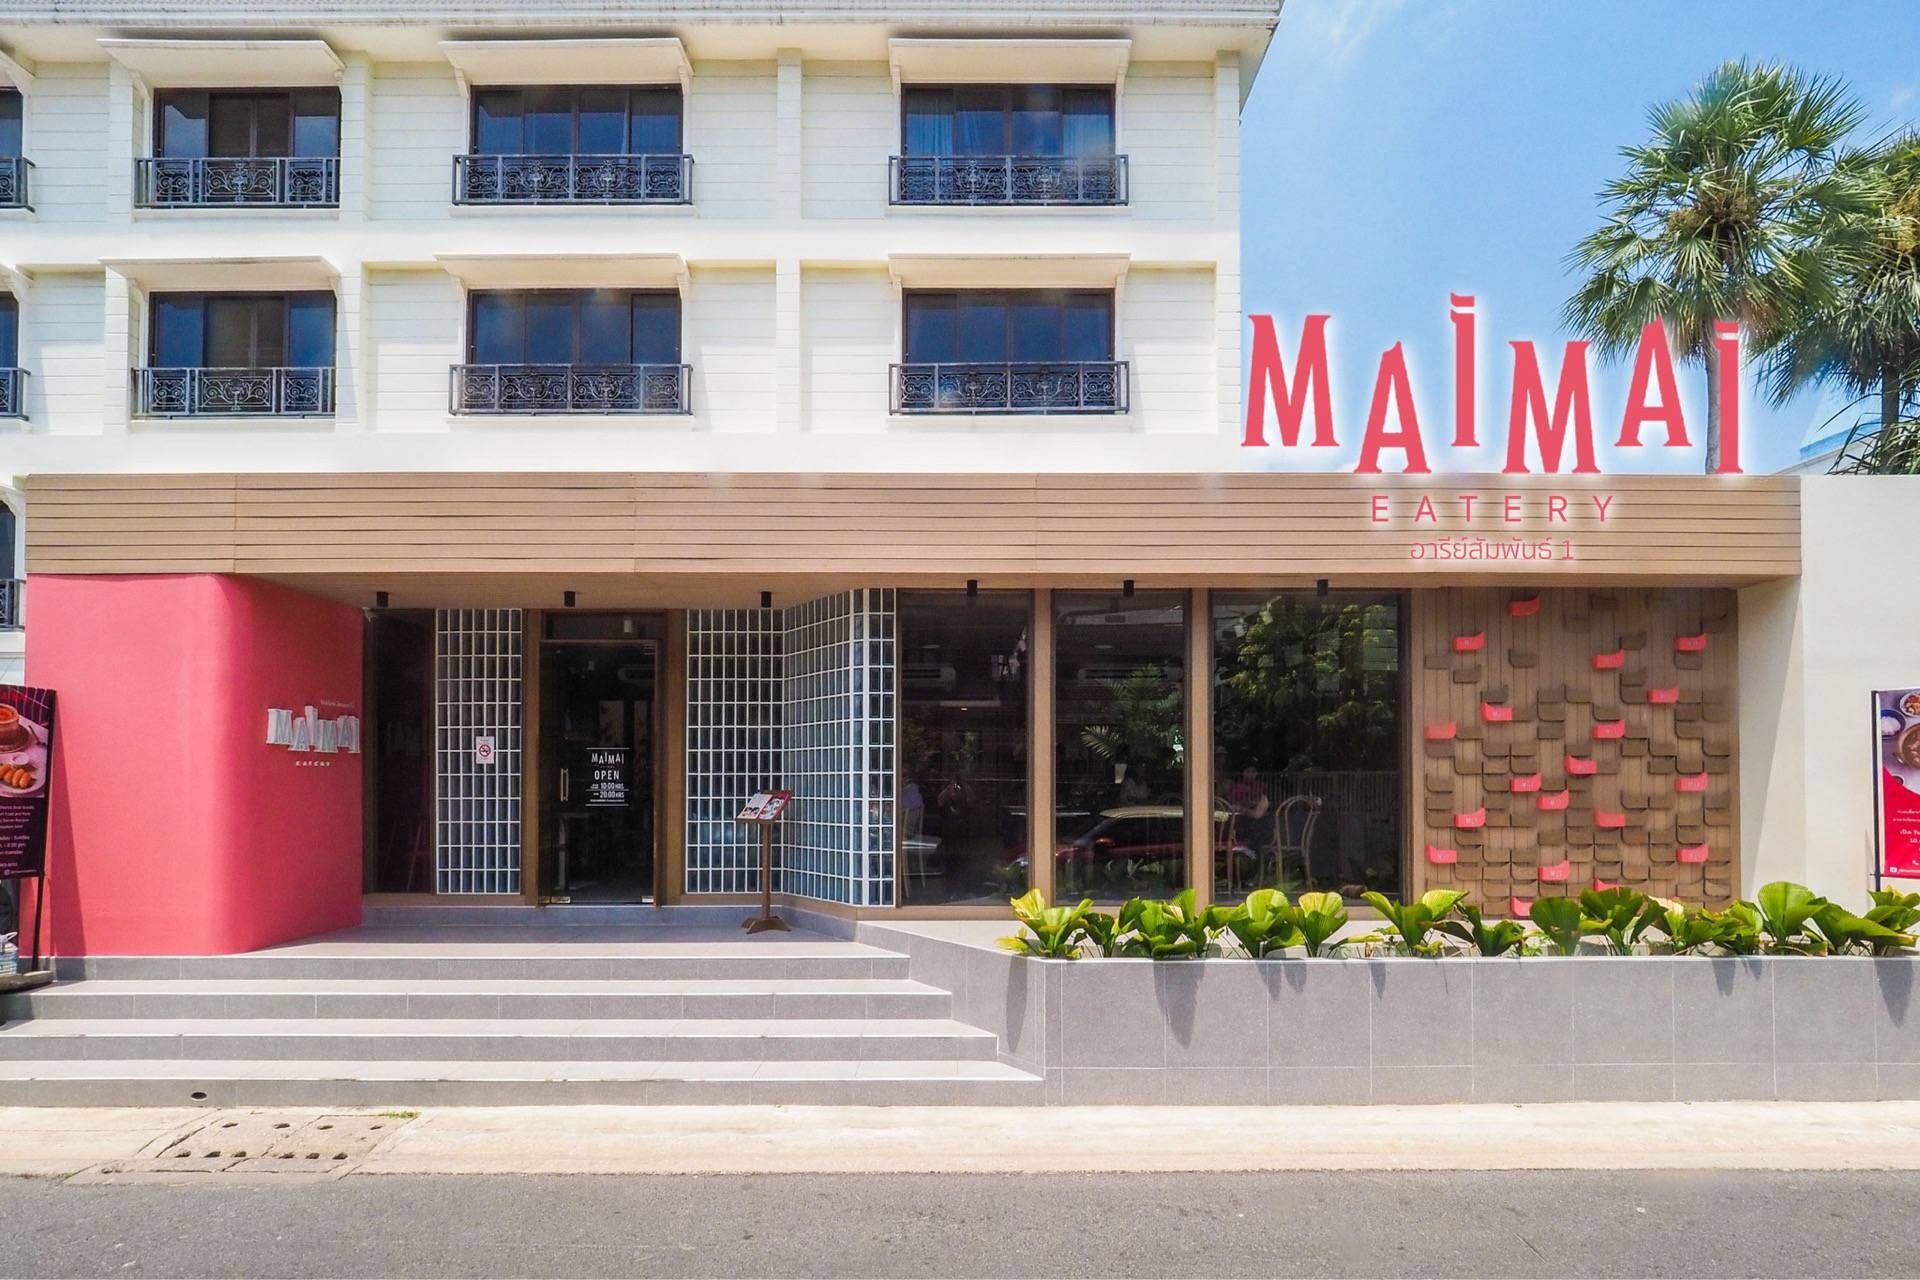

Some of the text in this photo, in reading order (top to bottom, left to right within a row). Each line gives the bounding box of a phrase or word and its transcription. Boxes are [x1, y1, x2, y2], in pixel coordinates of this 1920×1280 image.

[1371, 495, 1613, 522] EATERY
[1410, 536, 1574, 560] อารีย์สัมพันธ์ 1
[592, 752, 624, 764] MAIMAI
[595, 770, 619, 780] OPEN
